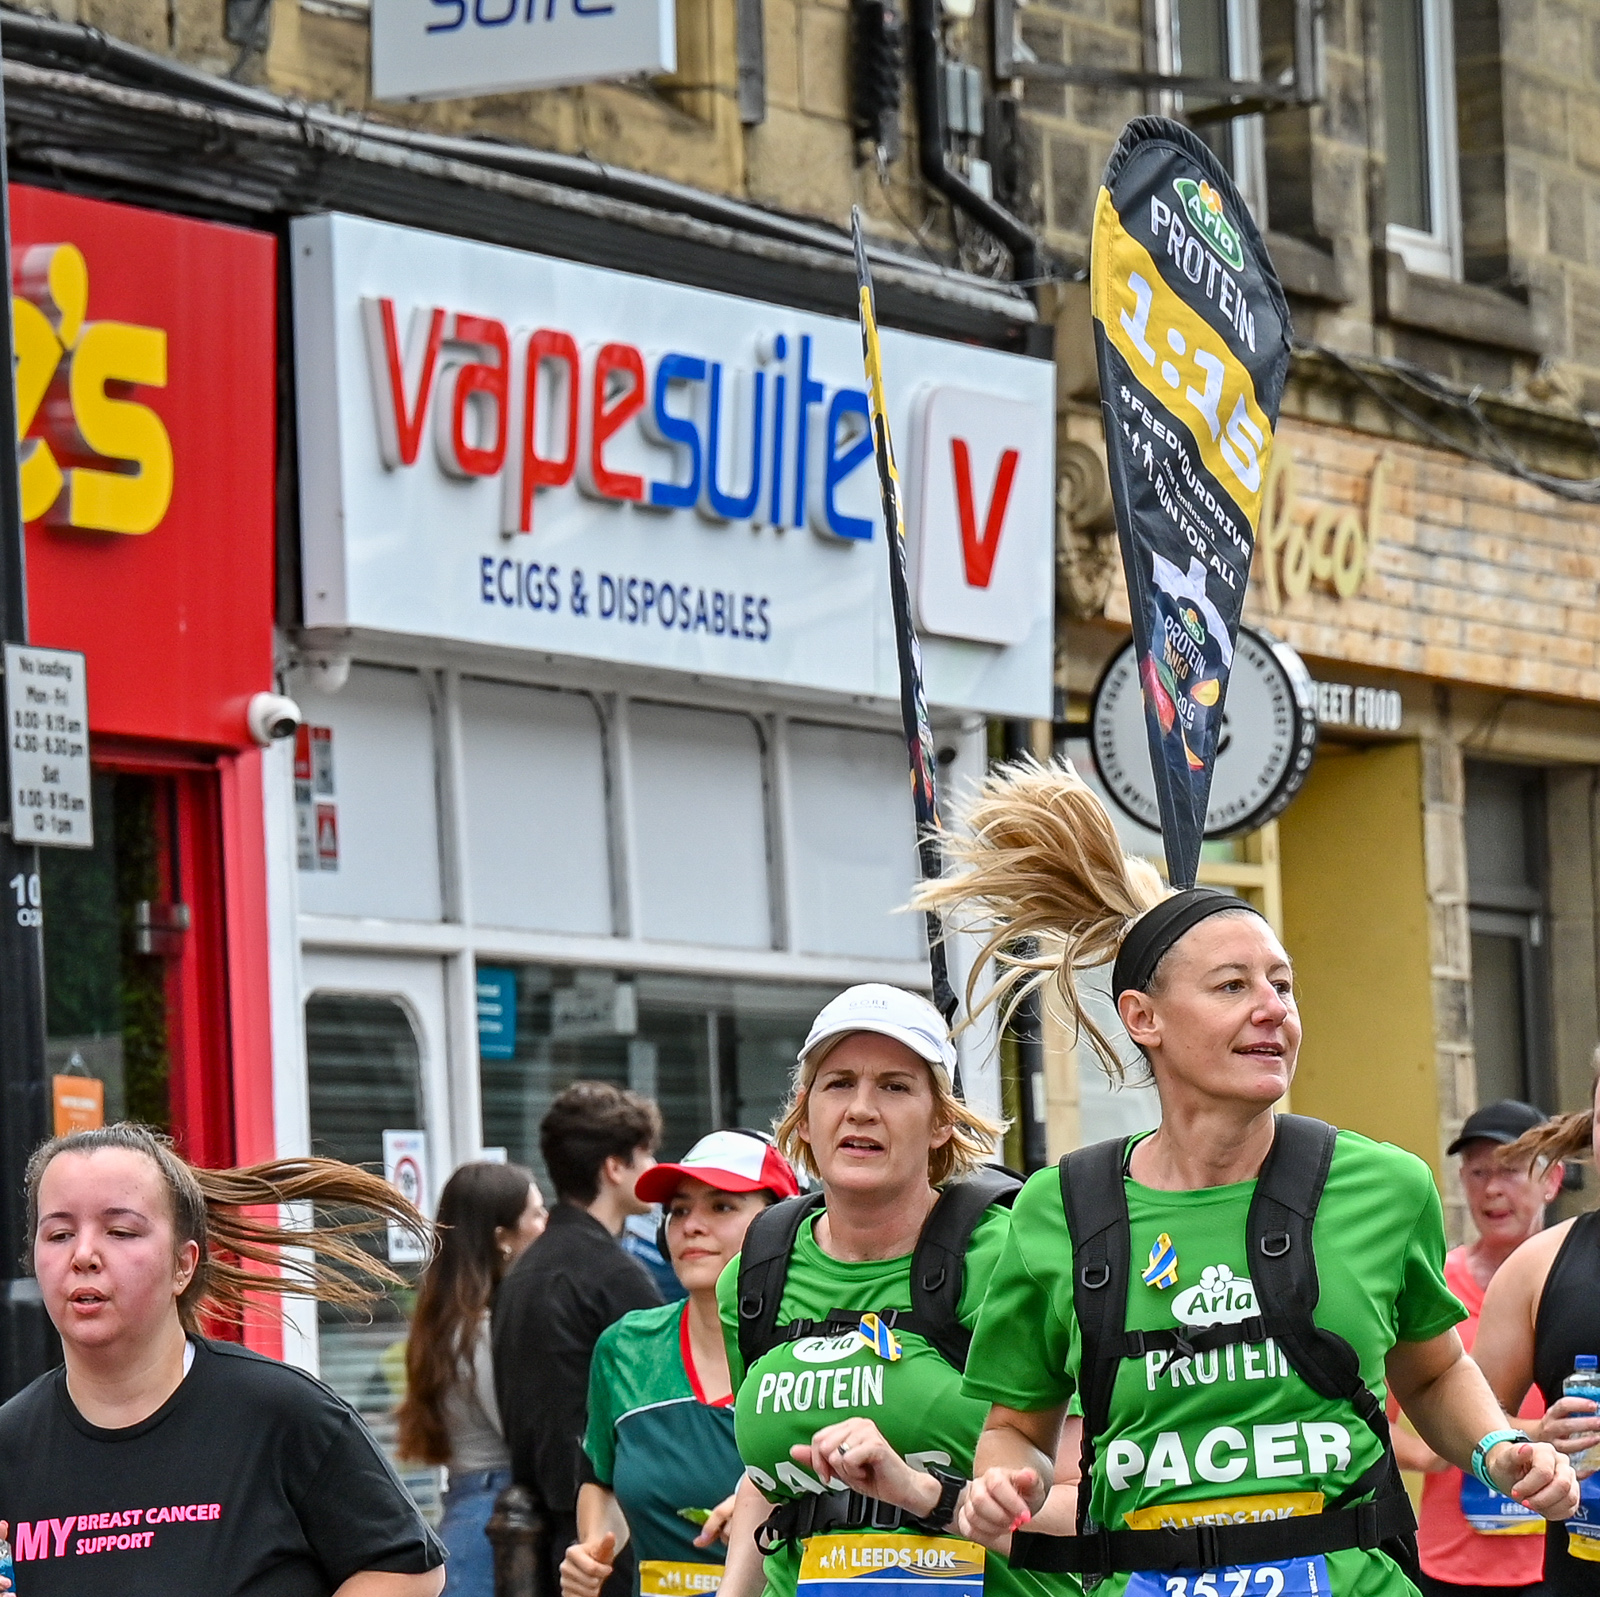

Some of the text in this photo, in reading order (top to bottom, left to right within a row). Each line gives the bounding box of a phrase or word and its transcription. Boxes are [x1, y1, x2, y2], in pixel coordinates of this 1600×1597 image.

[1187, 194, 1232, 256] Arla
[1151, 195, 1256, 353] PROTEIN
[1120, 271, 1264, 493] 1:15
[1120, 385, 1251, 560] #FEEDYOURDRIVE
[1164, 457, 1215, 542] Jane Tomlinson's
[1155, 473, 1236, 590] RUN FOR ALL
[480, 556, 772, 643] ECIGS & DISPOSABLES
[1164, 615, 1207, 678] PROTEIN
[1355, 686, 1402, 731] FOOD
[1187, 1287, 1253, 1316] Arla
[756, 1365, 884, 1414] PROTEIN
[1106, 1421, 1352, 1492] PACER
[15, 1516, 76, 1562] MY
[75, 1531, 154, 1556] SUPPORT
[77, 1503, 221, 1532] BREAST CANCER
[685, 1573, 721, 1590] LEED
[851, 1547, 956, 1569] LEEDS 10K
[1307, 1562, 1319, 1593] WILSON
